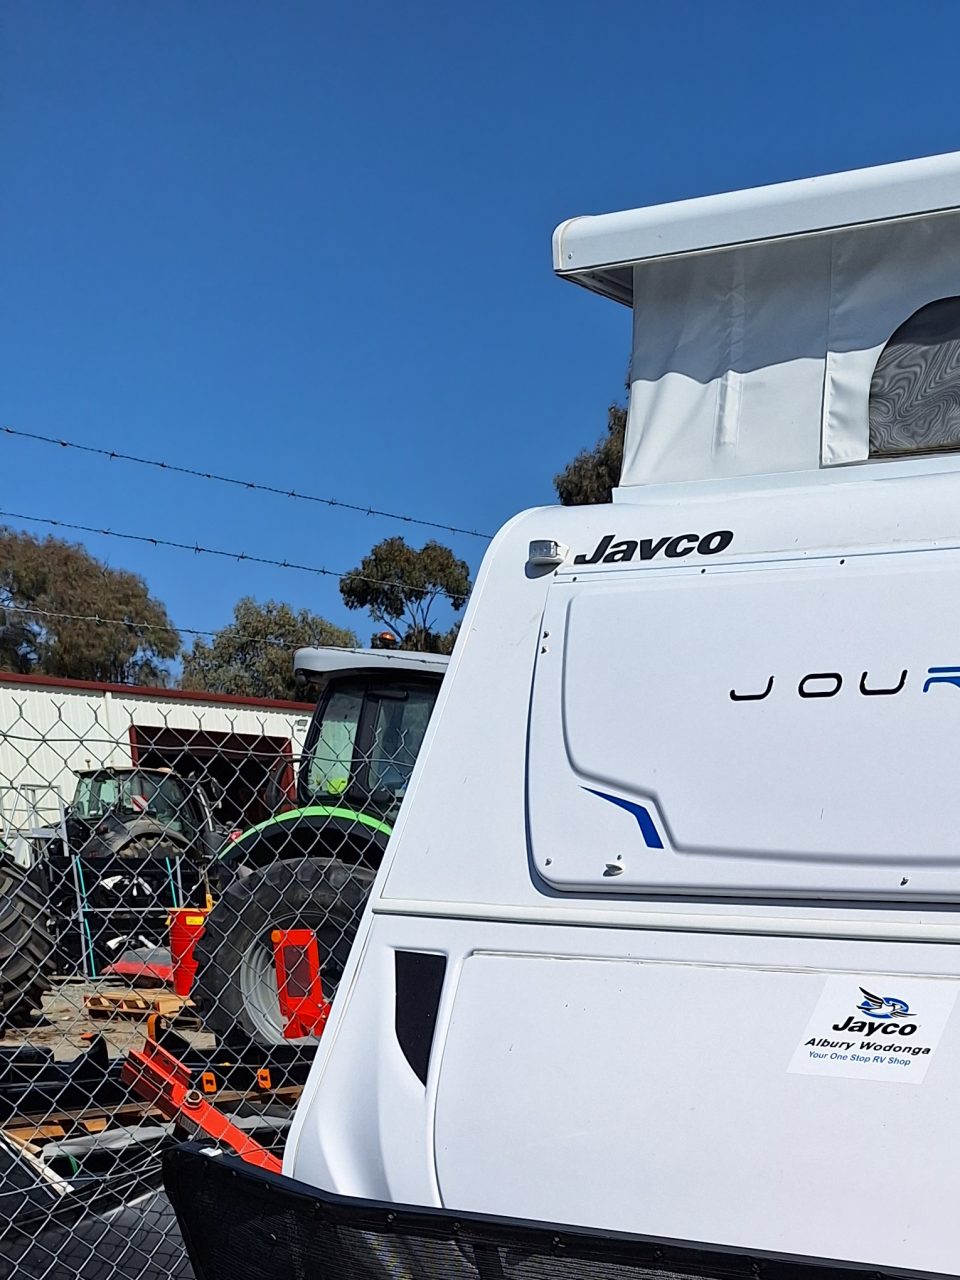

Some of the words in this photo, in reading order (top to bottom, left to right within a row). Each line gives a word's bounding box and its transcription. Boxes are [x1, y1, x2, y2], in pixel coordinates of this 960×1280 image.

[832, 1016, 917, 1037] Jayco
[804, 1037, 855, 1051] Albury
[859, 1041, 932, 1056] Wodonga
[808, 1050, 829, 1060] Your
[829, 1052, 848, 1062] One
[849, 1054, 871, 1065] Stop
[872, 1055, 886, 1065] RV
[887, 1056, 911, 1067] Shop
